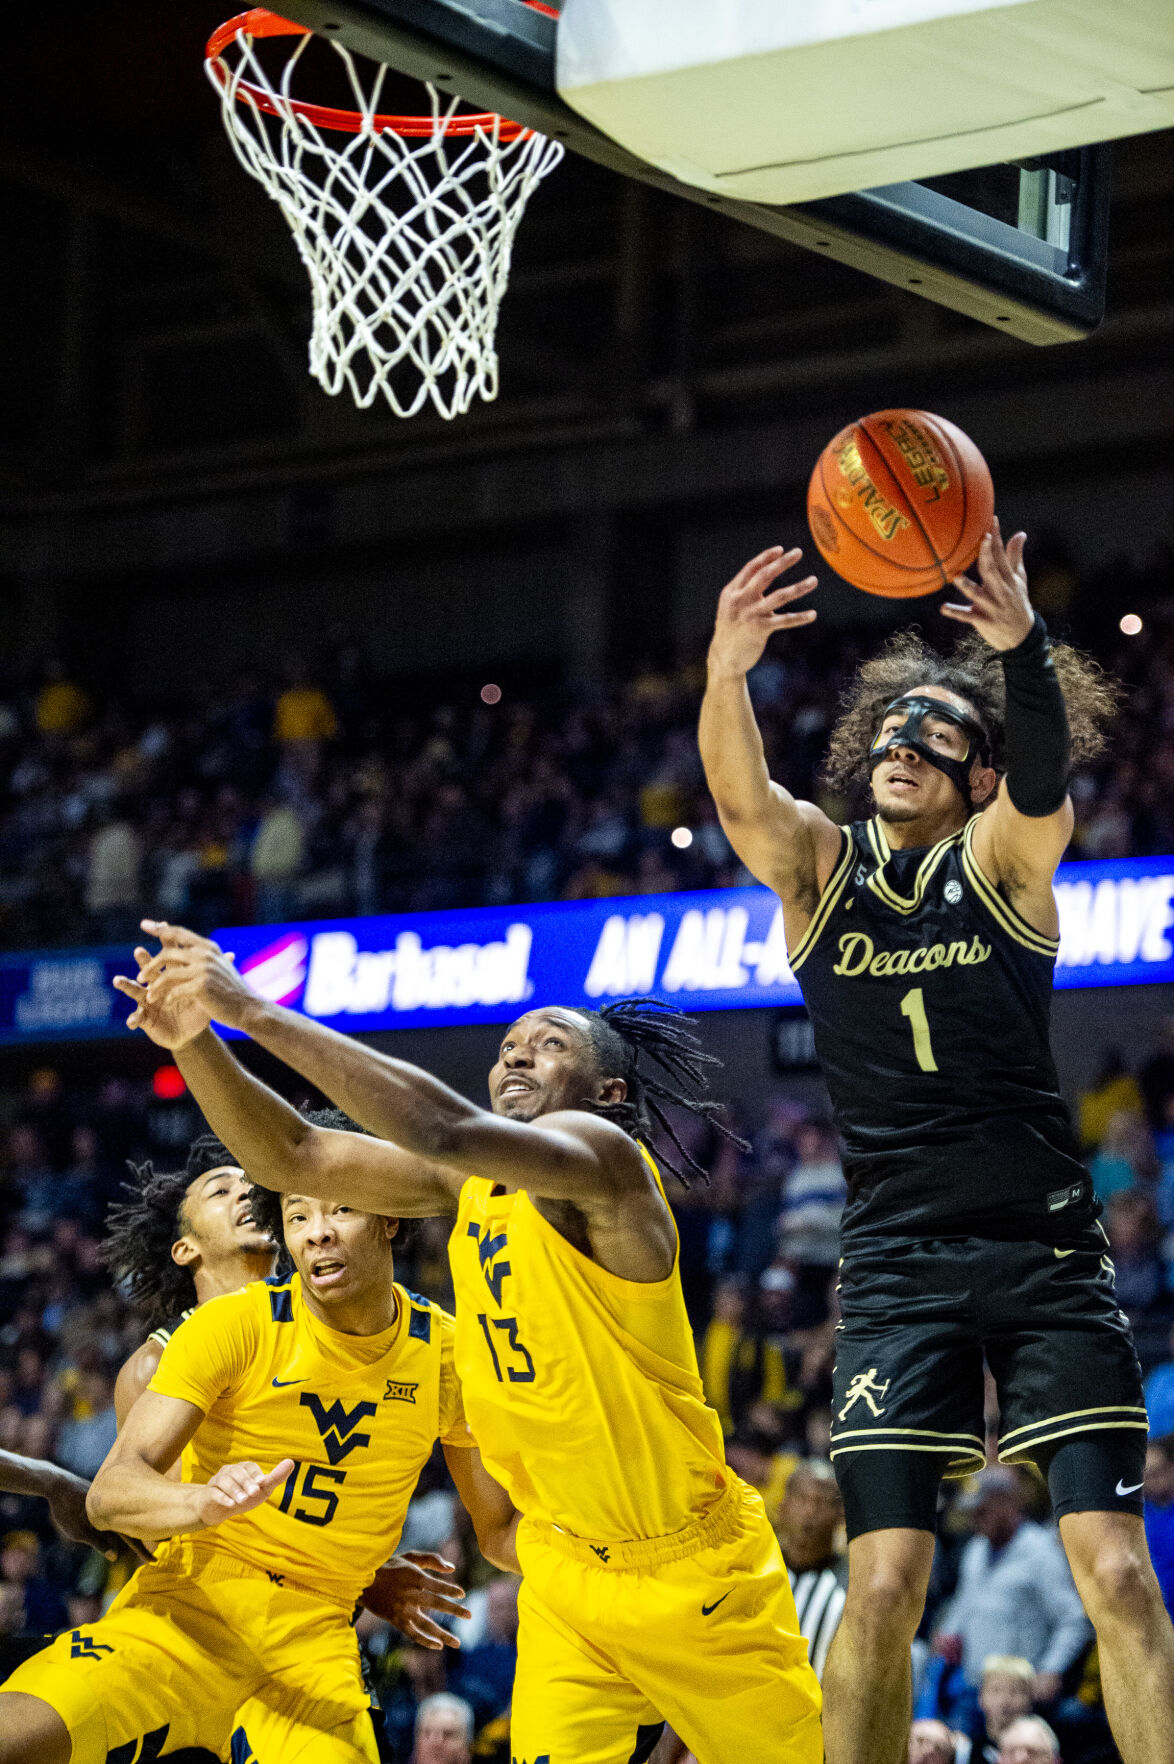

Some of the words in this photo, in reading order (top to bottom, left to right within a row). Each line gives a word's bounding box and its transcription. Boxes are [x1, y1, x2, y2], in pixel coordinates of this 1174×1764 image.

[833, 933, 992, 977] Deacons
[900, 987, 939, 1072] 1
[477, 1313, 536, 1383] 13
[278, 1461, 347, 1527] 15
